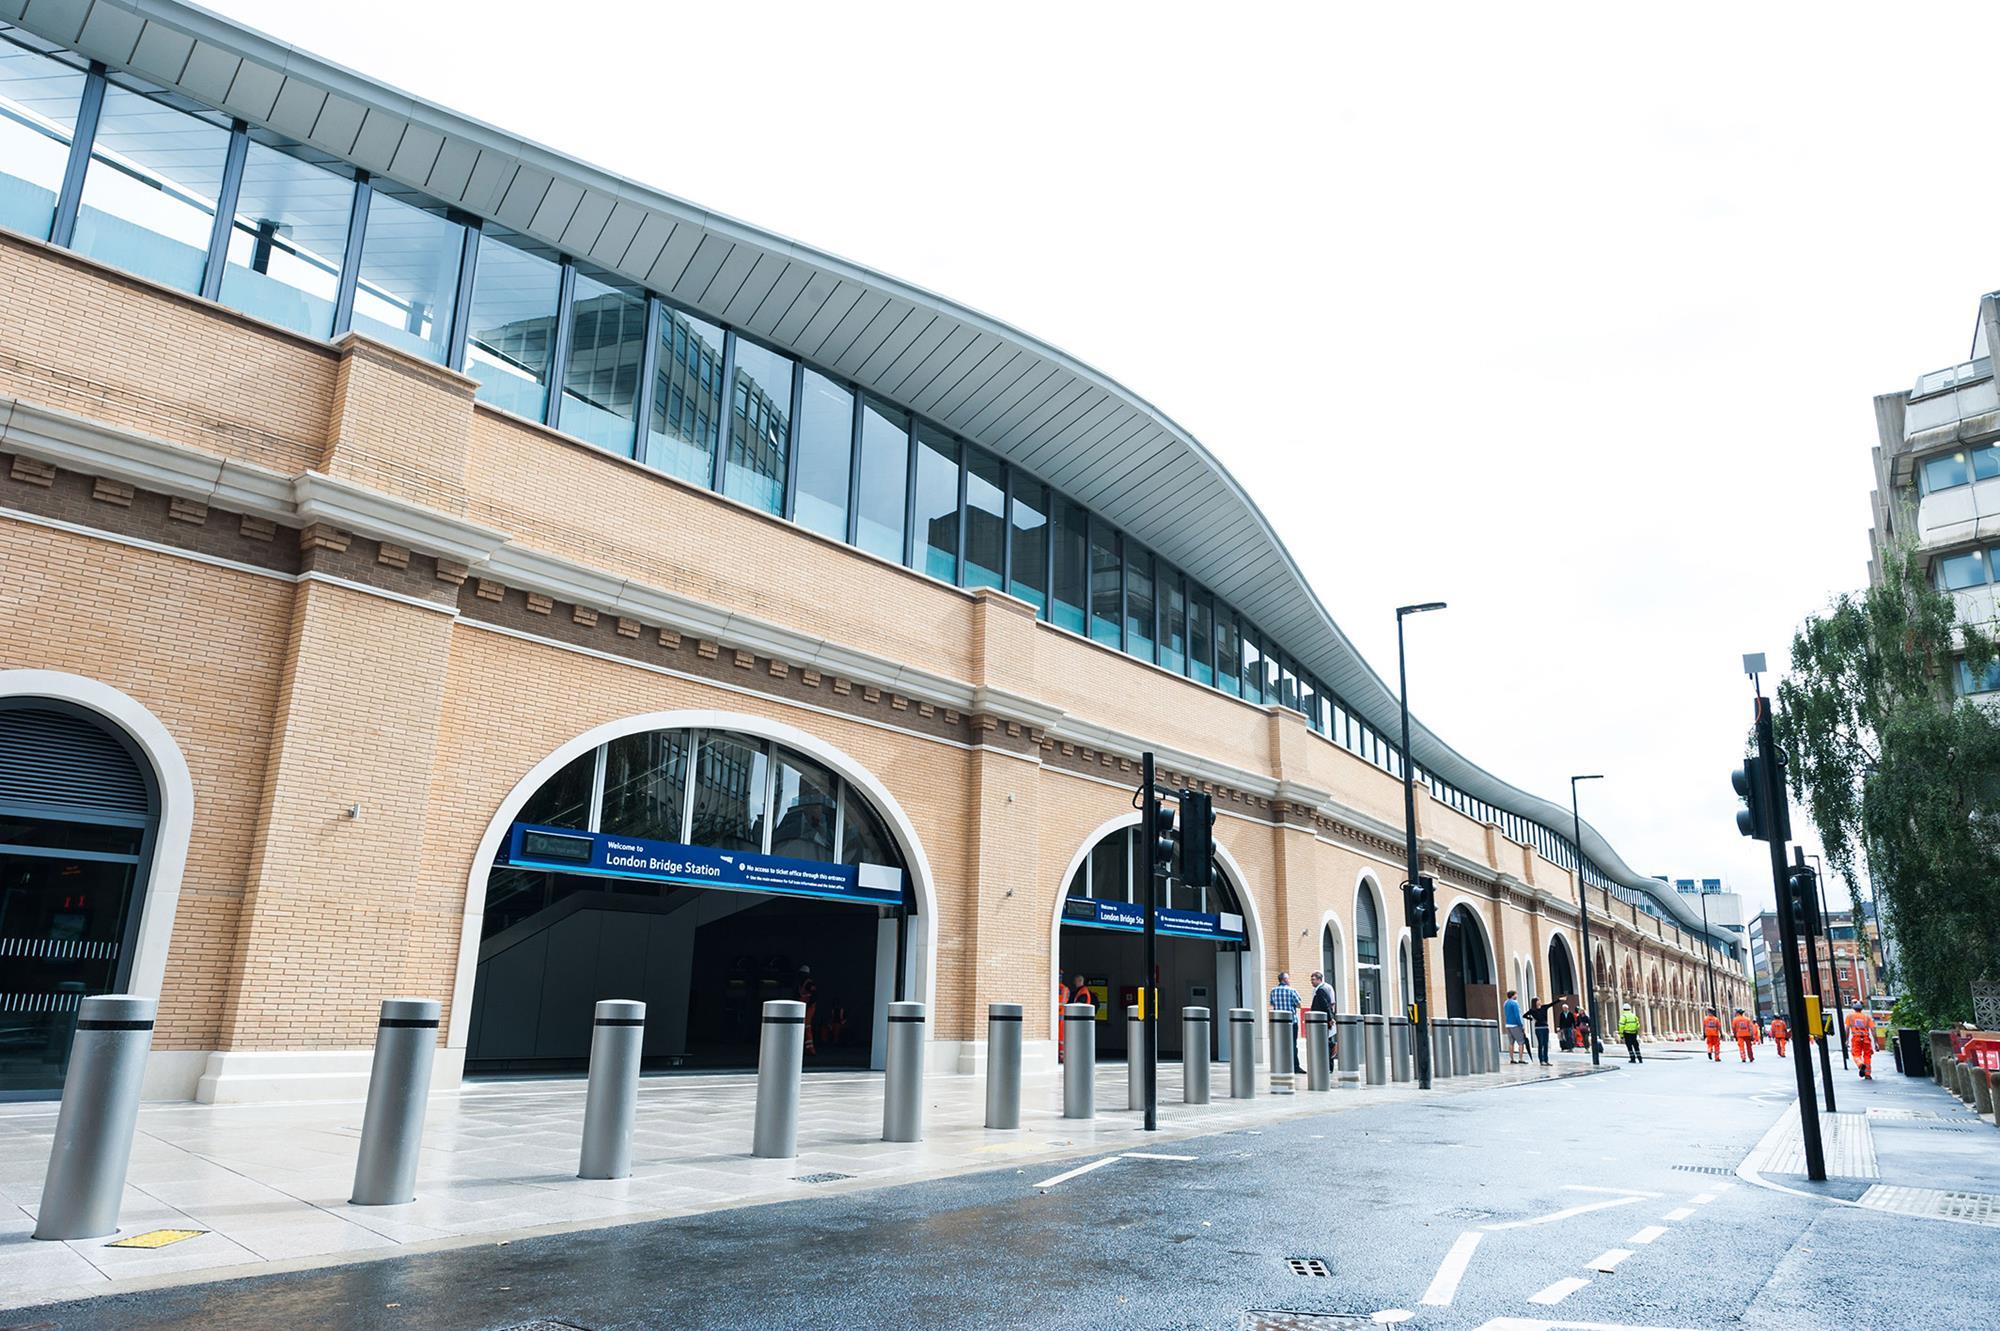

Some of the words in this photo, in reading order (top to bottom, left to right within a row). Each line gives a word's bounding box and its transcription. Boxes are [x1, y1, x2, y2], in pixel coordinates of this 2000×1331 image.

[607, 841, 635, 852] Welcome
[605, 852, 647, 869] London
[649, 857, 683, 874] Bridge
[684, 861, 721, 876] Station
[754, 866, 769, 874] access
[776, 868, 789, 876] ticket
[789, 869, 802, 877] office
[802, 871, 819, 880] through
[828, 874, 846, 882] entrance
[1100, 911, 1120, 922] London
[1119, 914, 1136, 925] Bridge
